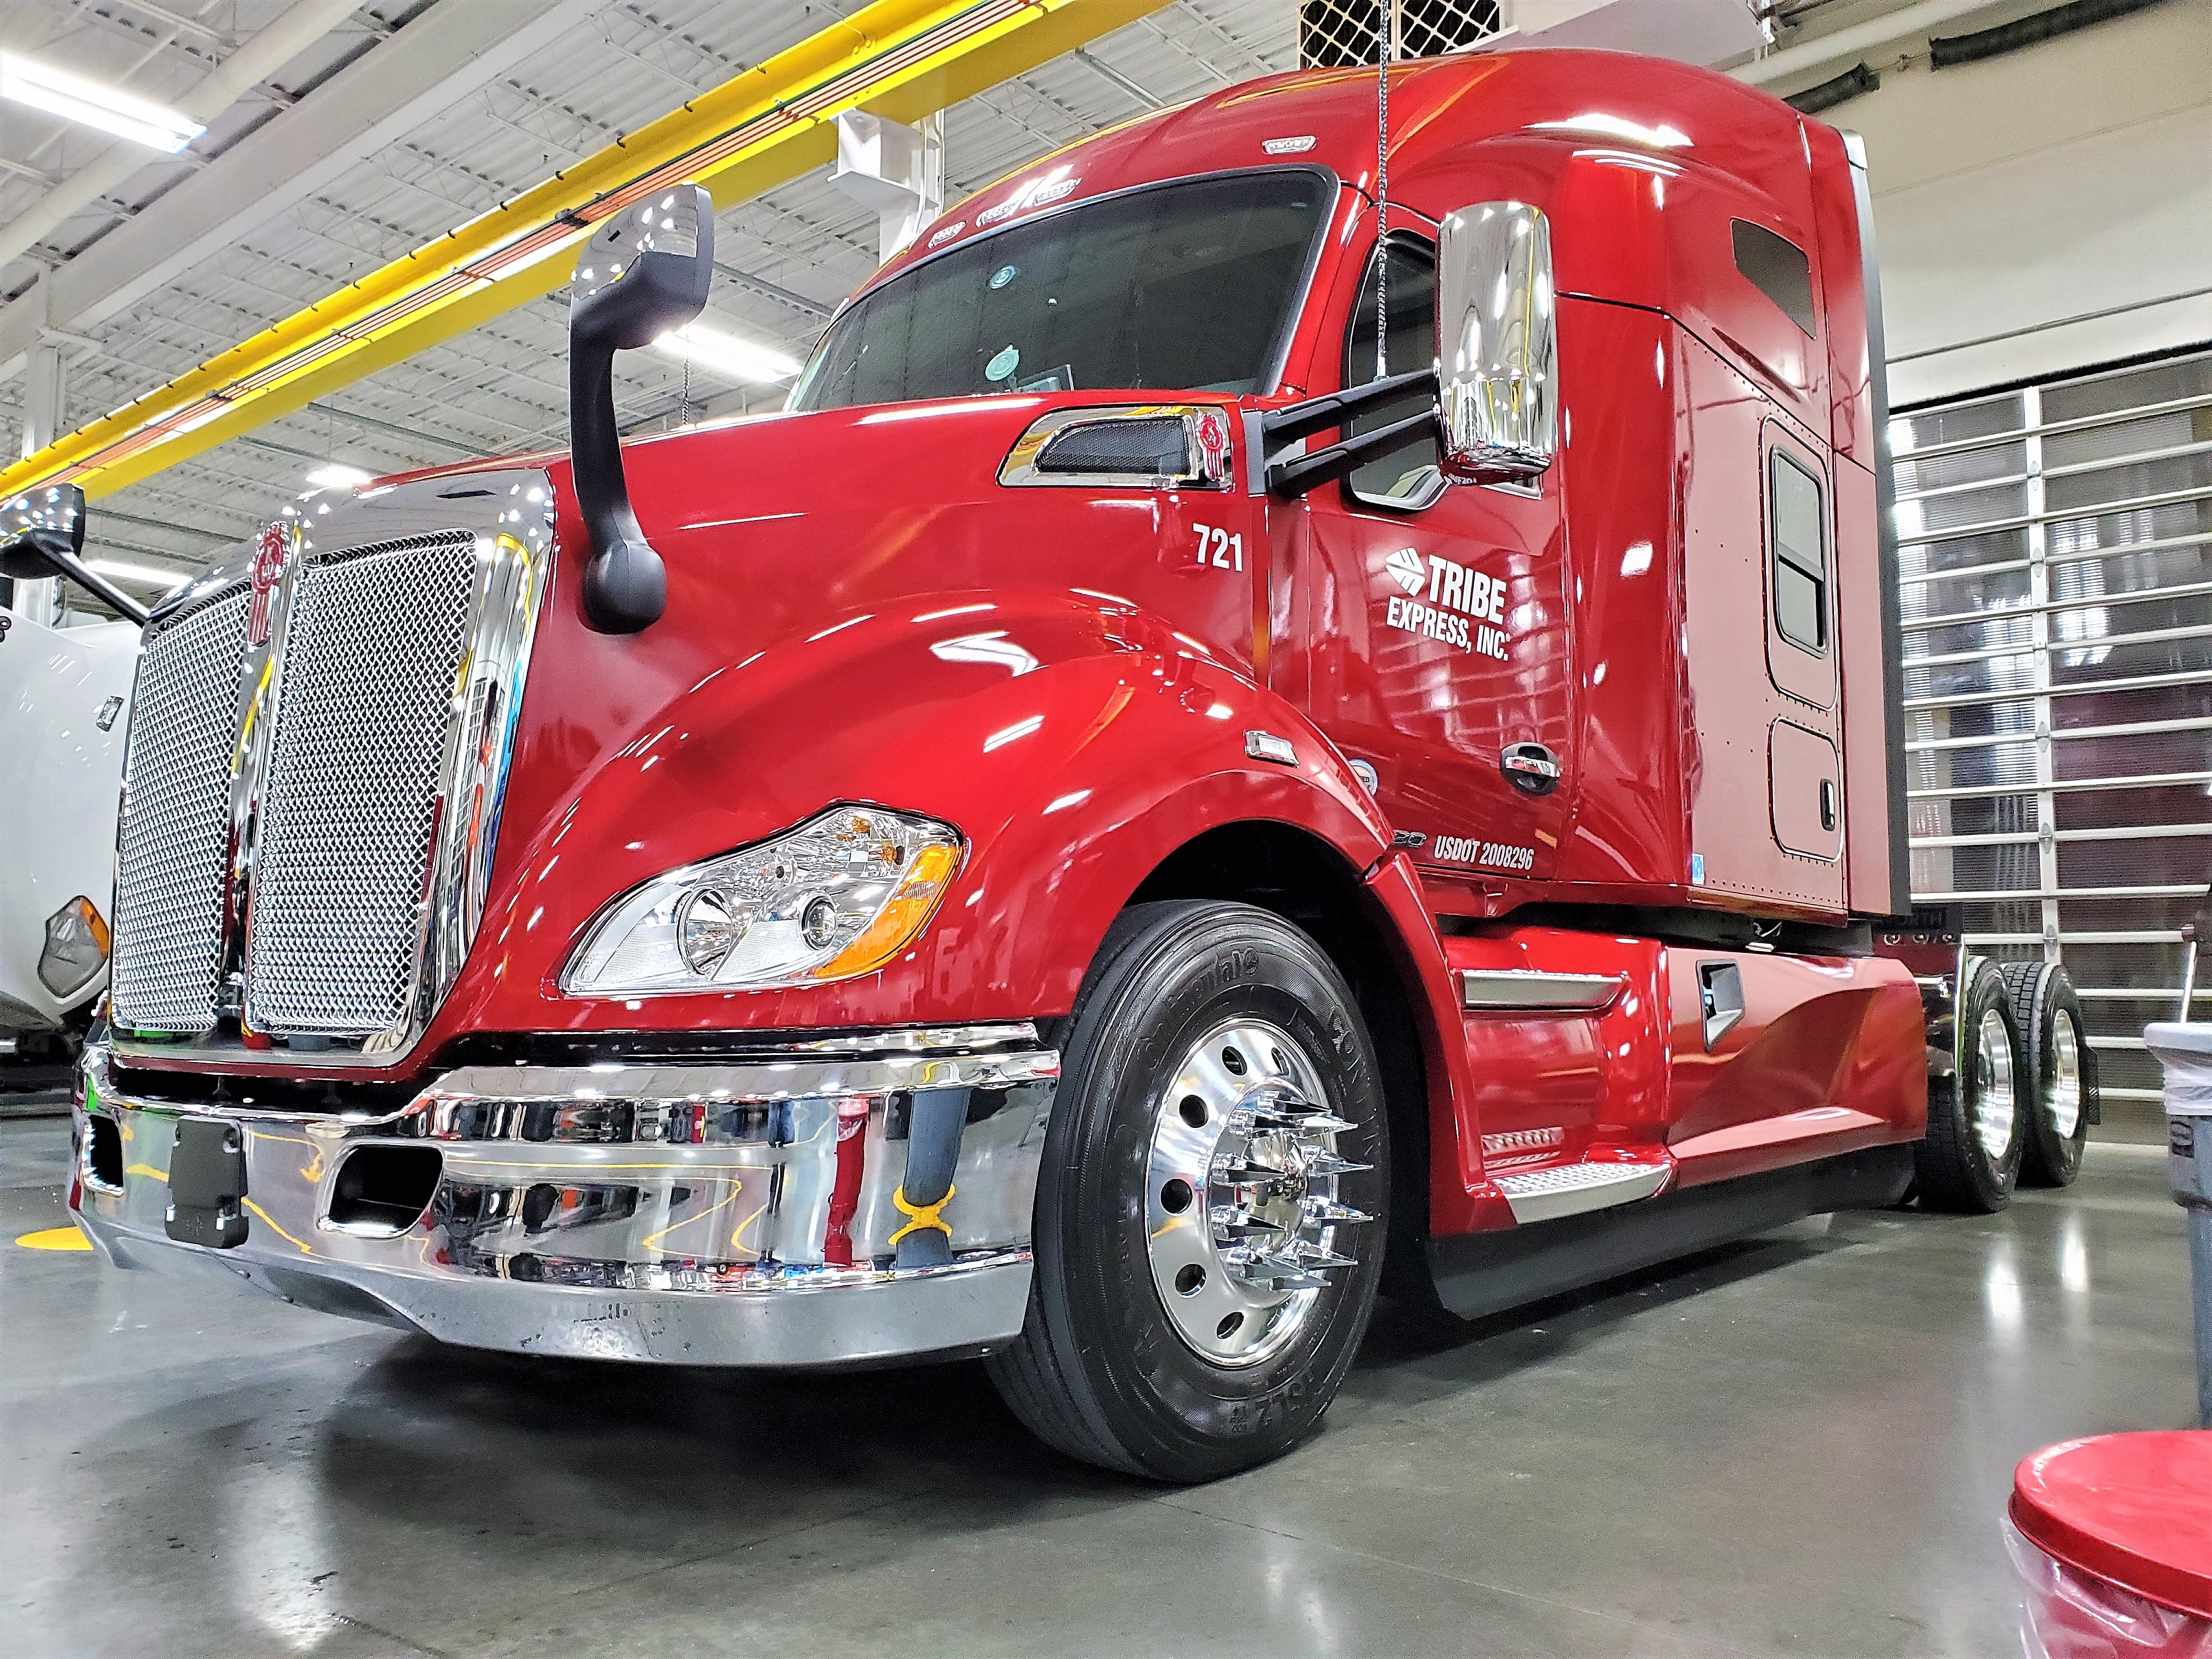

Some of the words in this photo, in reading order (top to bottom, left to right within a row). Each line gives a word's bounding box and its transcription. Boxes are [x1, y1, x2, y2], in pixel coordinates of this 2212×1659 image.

[1193, 522, 1243, 572] 721
[1427, 554, 1507, 625] TRIBE
[1386, 595, 1472, 654] EXPRESS,
[1476, 624, 1510, 661] INC.
[1434, 835, 1481, 864] USDOT
[1479, 842, 1534, 871] 2008296
